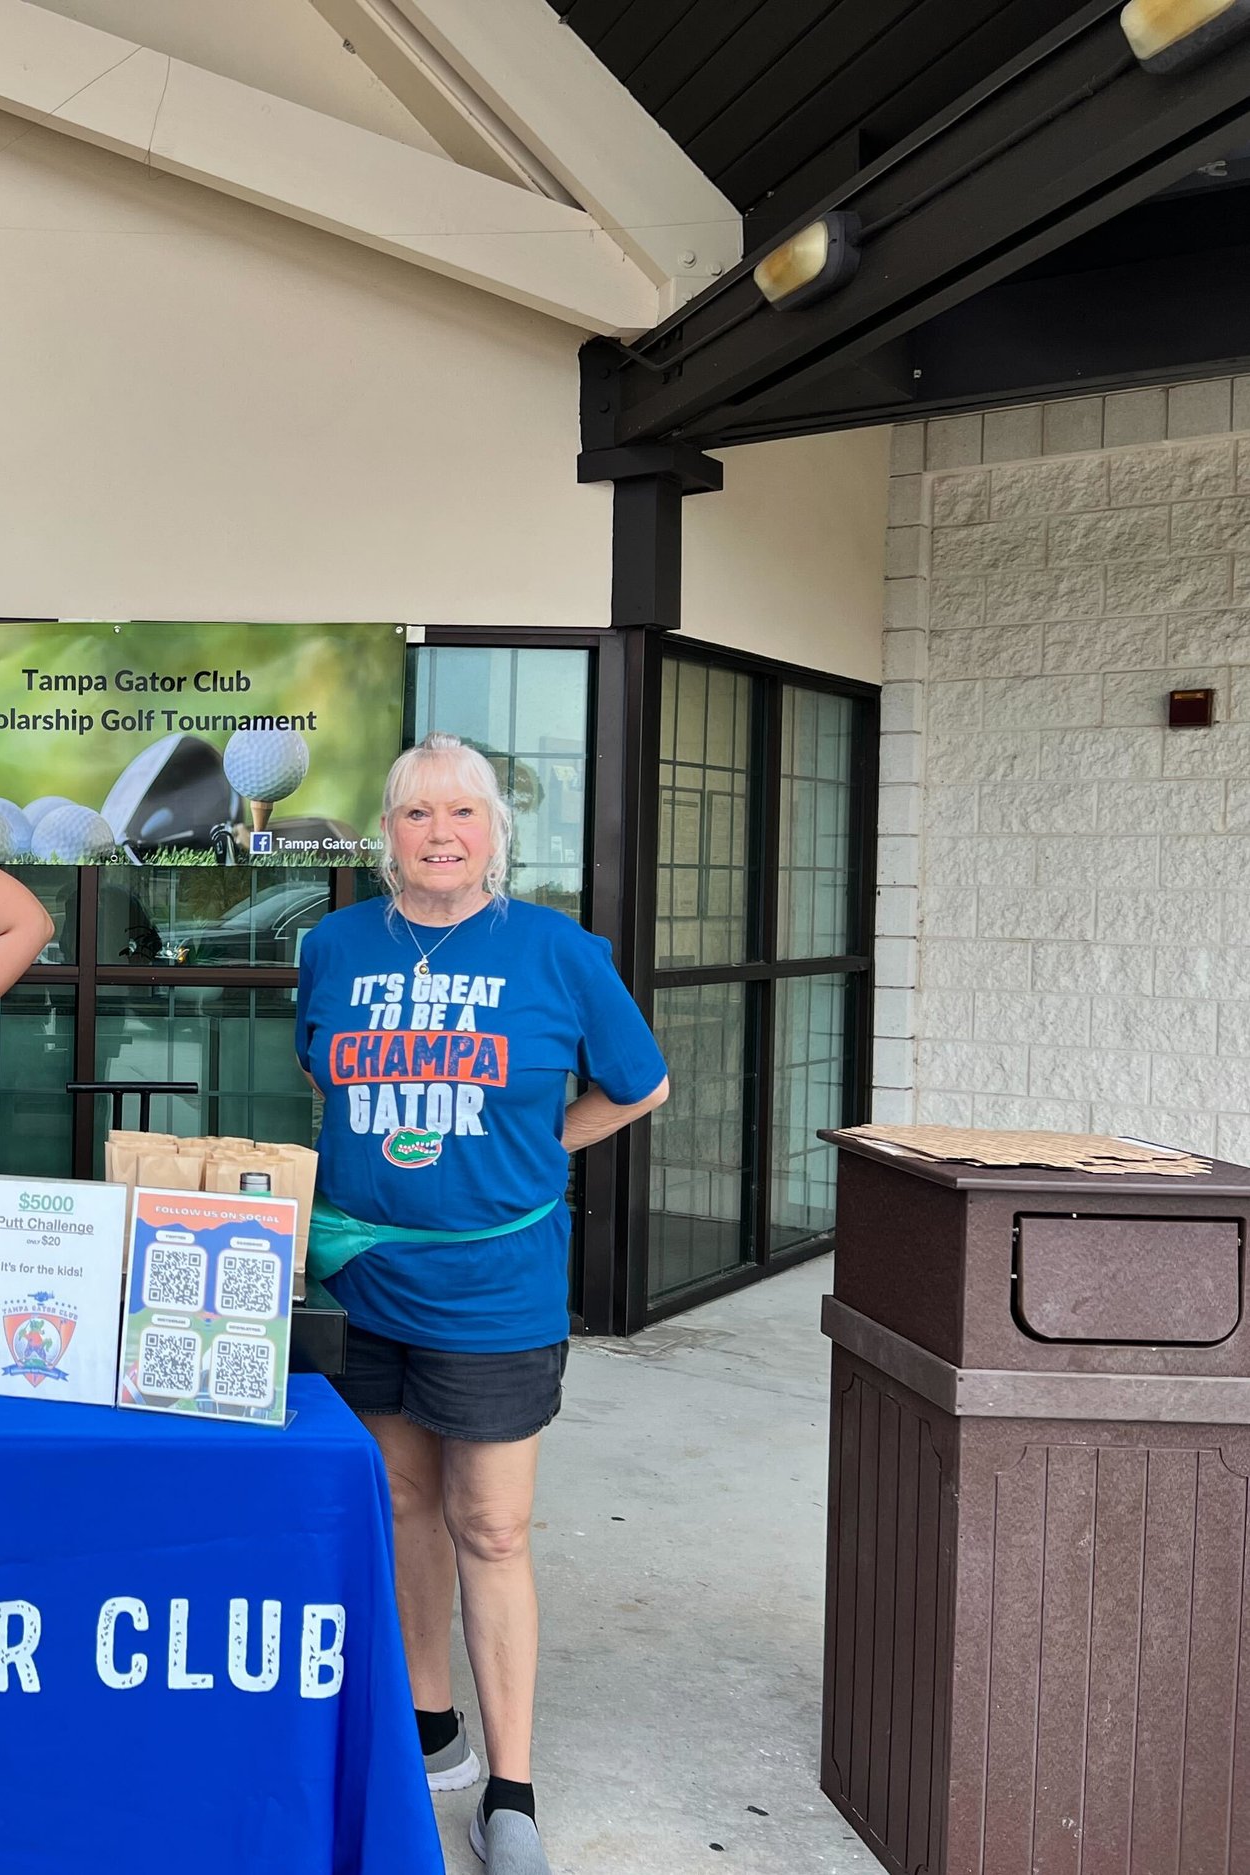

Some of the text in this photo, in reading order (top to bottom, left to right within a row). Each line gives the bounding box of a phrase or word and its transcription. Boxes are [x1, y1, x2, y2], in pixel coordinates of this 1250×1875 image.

[22, 669, 251, 696] Tampa Gator Club
[100, 708, 154, 731] Golf
[161, 709, 317, 732] Tournament
[276, 837, 319, 851] Tampa
[322, 837, 357, 850] Gator
[359, 837, 384, 850] Club
[350, 973, 506, 1008] IT'S GREAT
[368, 1003, 476, 1032] TO BE A
[335, 1034, 500, 1081] CHAMPA
[18, 1192, 74, 1213] $5000
[155, 1205, 280, 1224] FOLLOW US ON SOCIAL
[27, 1217, 94, 1235] Challenge
[41, 1235, 61, 1246] $20
[0, 1261, 84, 1278] It's for the kids!
[95, 1596, 346, 1699] CLUB
